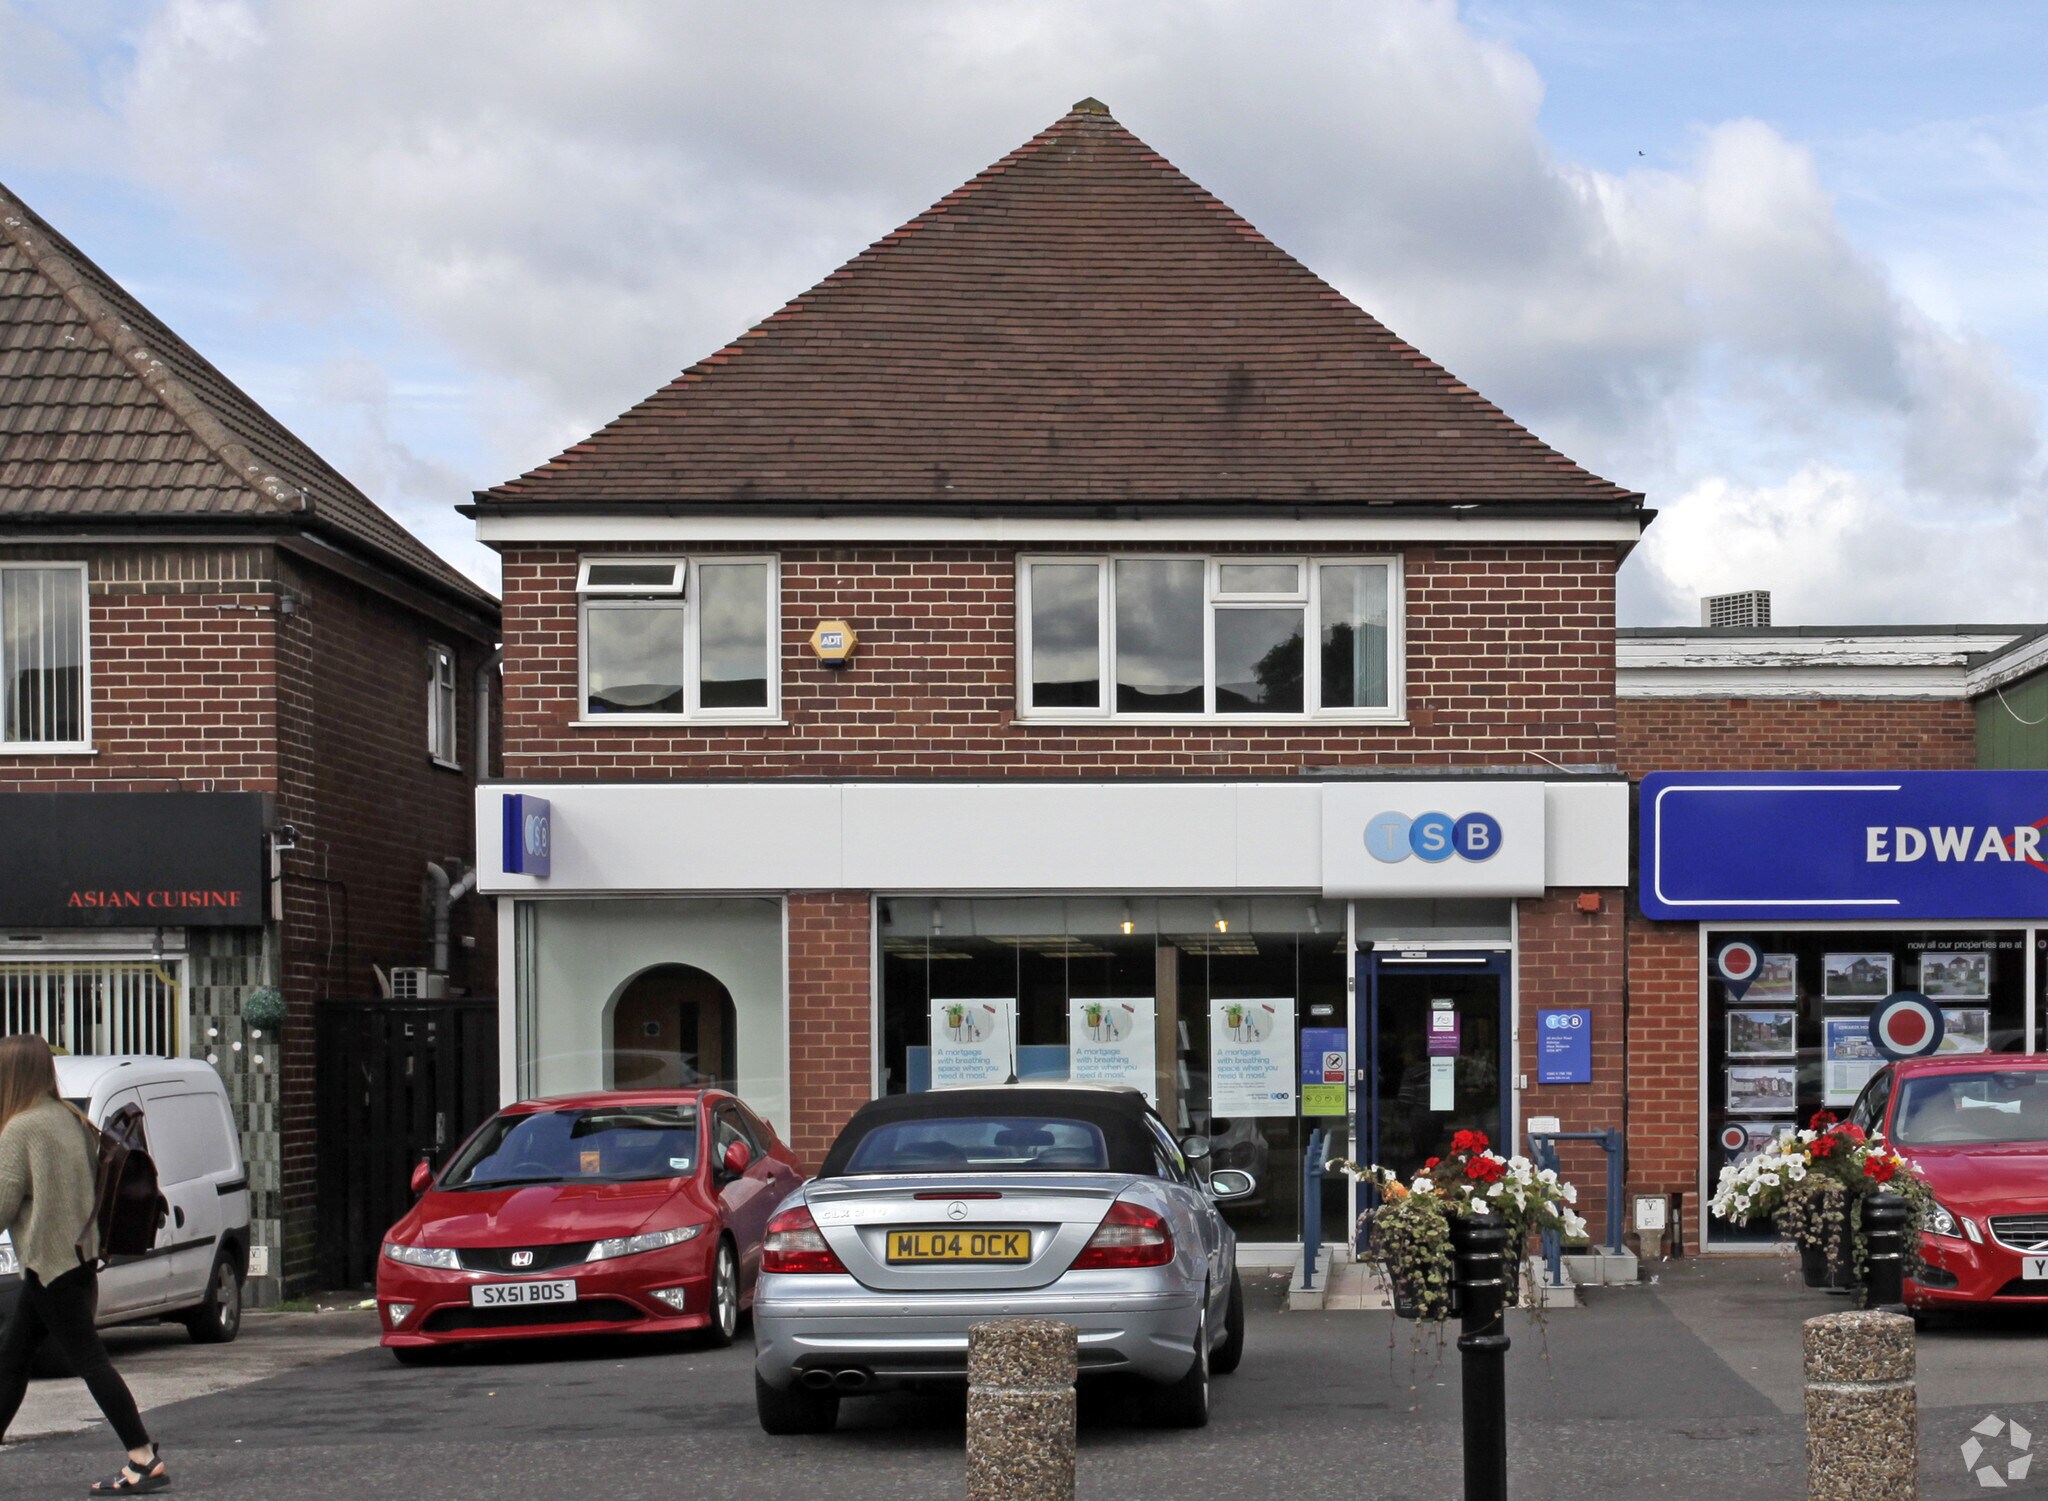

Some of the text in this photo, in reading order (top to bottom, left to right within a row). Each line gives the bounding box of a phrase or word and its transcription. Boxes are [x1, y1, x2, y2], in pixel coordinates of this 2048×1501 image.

[821, 635, 842, 646] ADT
[1377, 820, 1492, 853] TSB
[1866, 826, 2044, 862] EDWAR
[67, 891, 243, 908] ASIAN CUISINE
[1927, 941, 1936, 949] all
[1954, 941, 1997, 951] properties
[2014, 941, 2022, 949] at
[946, 1049, 982, 1057] mortgage
[1084, 1048, 1121, 1056] mortgage
[1225, 1049, 1261, 1057] mortgage
[955, 1057, 991, 1065] breathing
[1235, 1057, 1270, 1065] breathing
[898, 1234, 1019, 1256] ML04 OCK
[2035, 1260, 2045, 1276] Y
[483, 1284, 565, 1303] SX51 BOS
